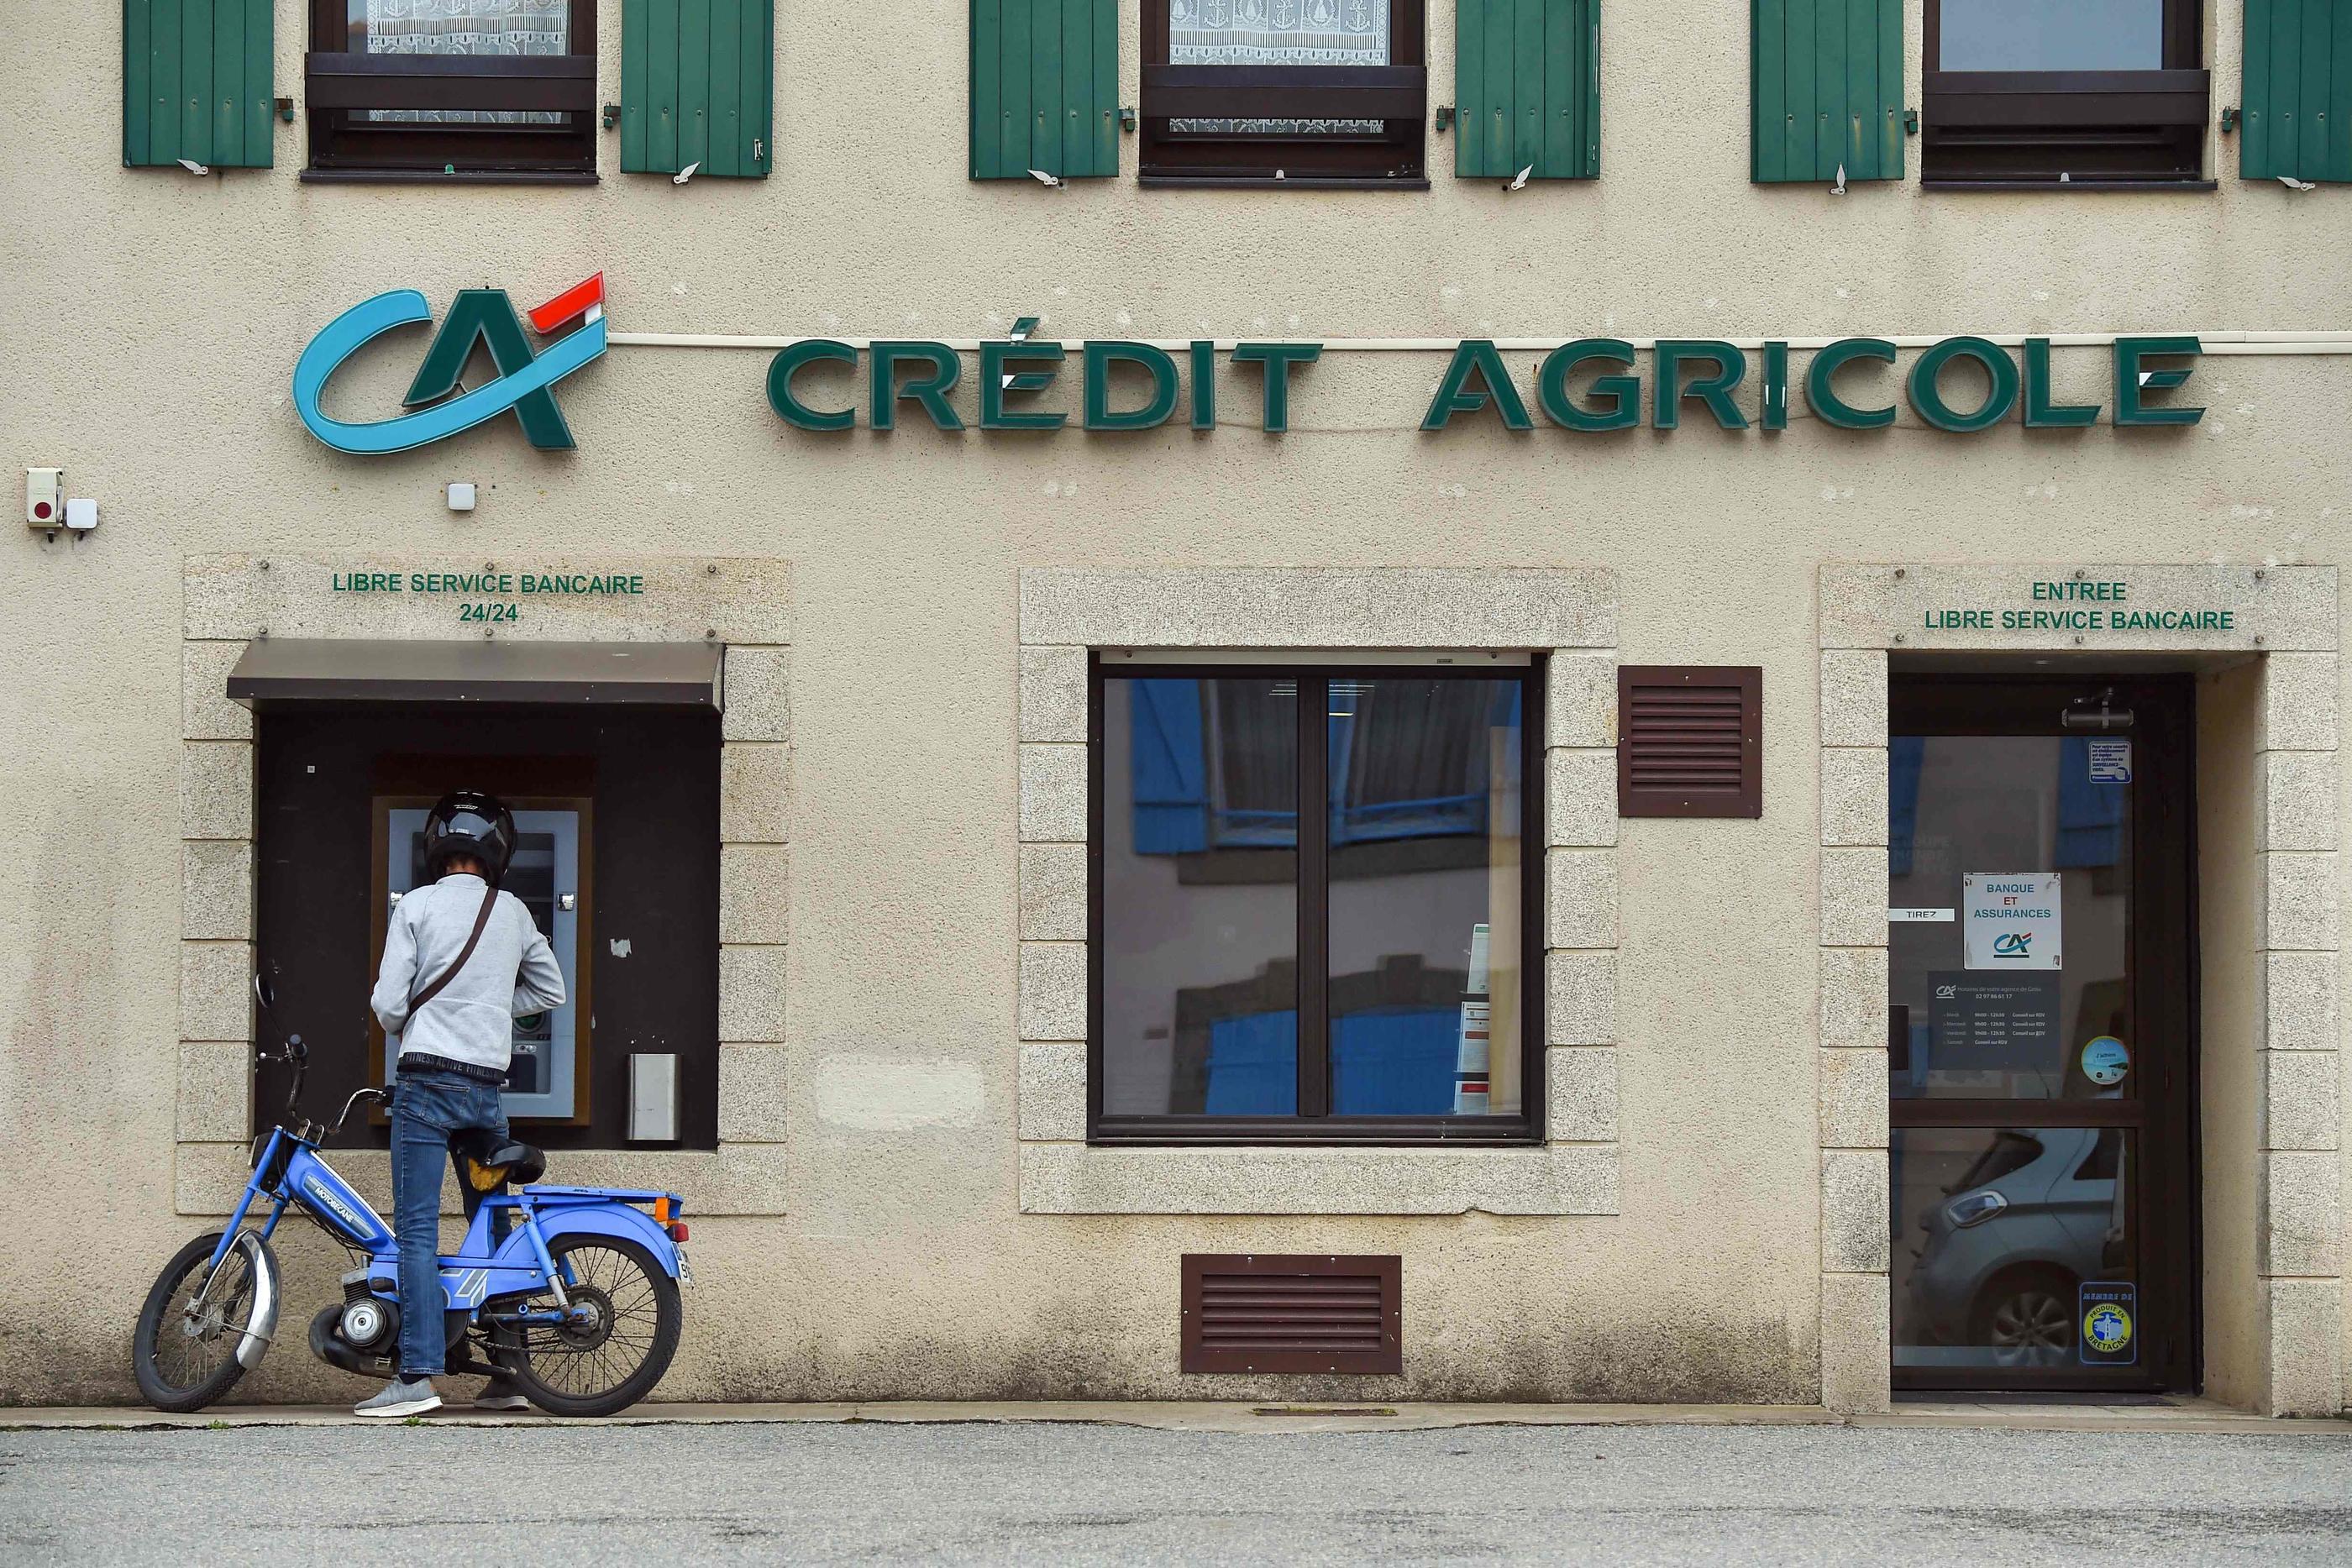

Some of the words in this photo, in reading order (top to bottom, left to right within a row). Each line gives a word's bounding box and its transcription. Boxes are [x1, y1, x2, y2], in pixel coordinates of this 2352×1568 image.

[292, 270, 606, 454] CA
[766, 317, 1324, 433] CRÉDIT
[1419, 336, 2207, 433] AGRICOLE
[333, 573, 402, 592] LIBRE
[410, 574, 512, 593] SERVICE
[520, 574, 643, 595] BANCAIRE
[2033, 582, 2127, 600] ENTREE
[459, 603, 518, 621] 24/24
[1924, 611, 1993, 629] LIBRE
[2002, 611, 2103, 629] SERVICE
[2112, 611, 2234, 630] BANCAIRE
[1987, 884, 2034, 894] BANQUE
[2003, 897, 2018, 905] ET
[1974, 909, 2051, 919] ASSURANCES
[406, 1052, 435, 1064] FITNESS
[436, 1058, 463, 1072] ACTIVE
[314, 1187, 354, 1223] MOTOBECANE
[2090, 1305, 2116, 1319] PRODUIT
[2088, 1335, 2128, 1350] BRETAGNE
